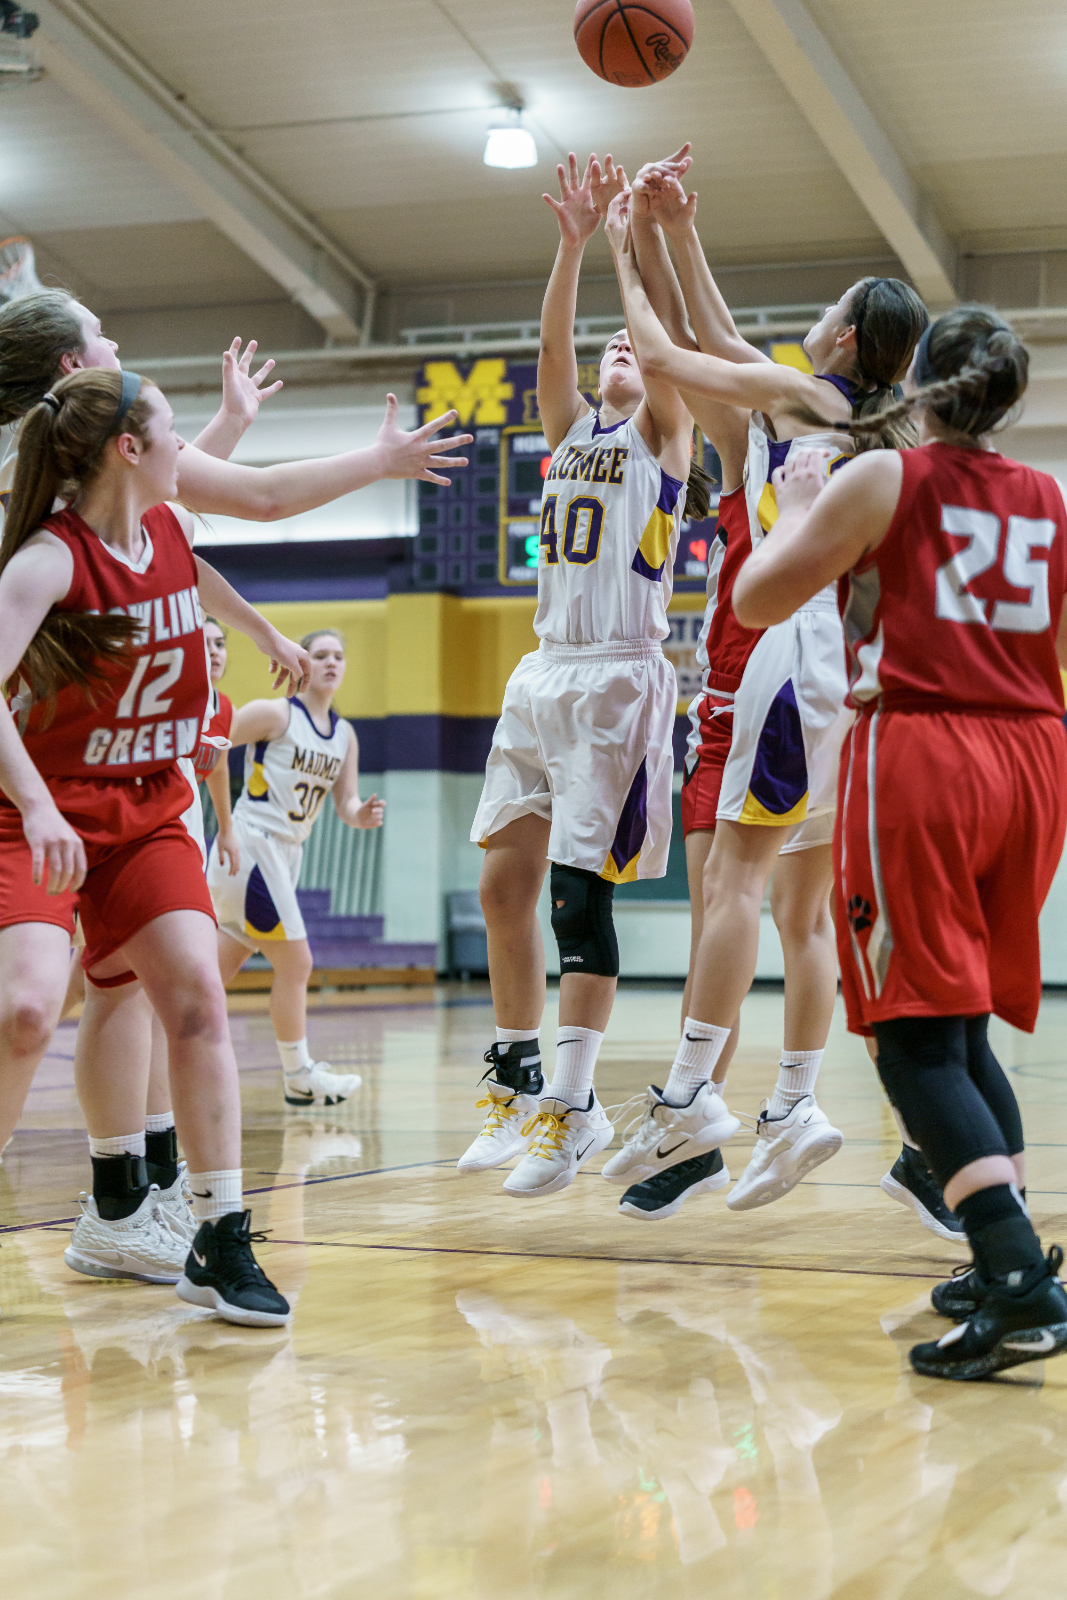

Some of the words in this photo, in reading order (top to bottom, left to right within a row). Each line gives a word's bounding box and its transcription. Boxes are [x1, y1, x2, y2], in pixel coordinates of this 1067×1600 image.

[540, 493, 606, 566] 40
[935, 503, 1056, 633] 25
[85, 585, 203, 649] WLING
[115, 647, 184, 719] 12
[83, 717, 198, 766] GREEN
[287, 782, 327, 823] 30
